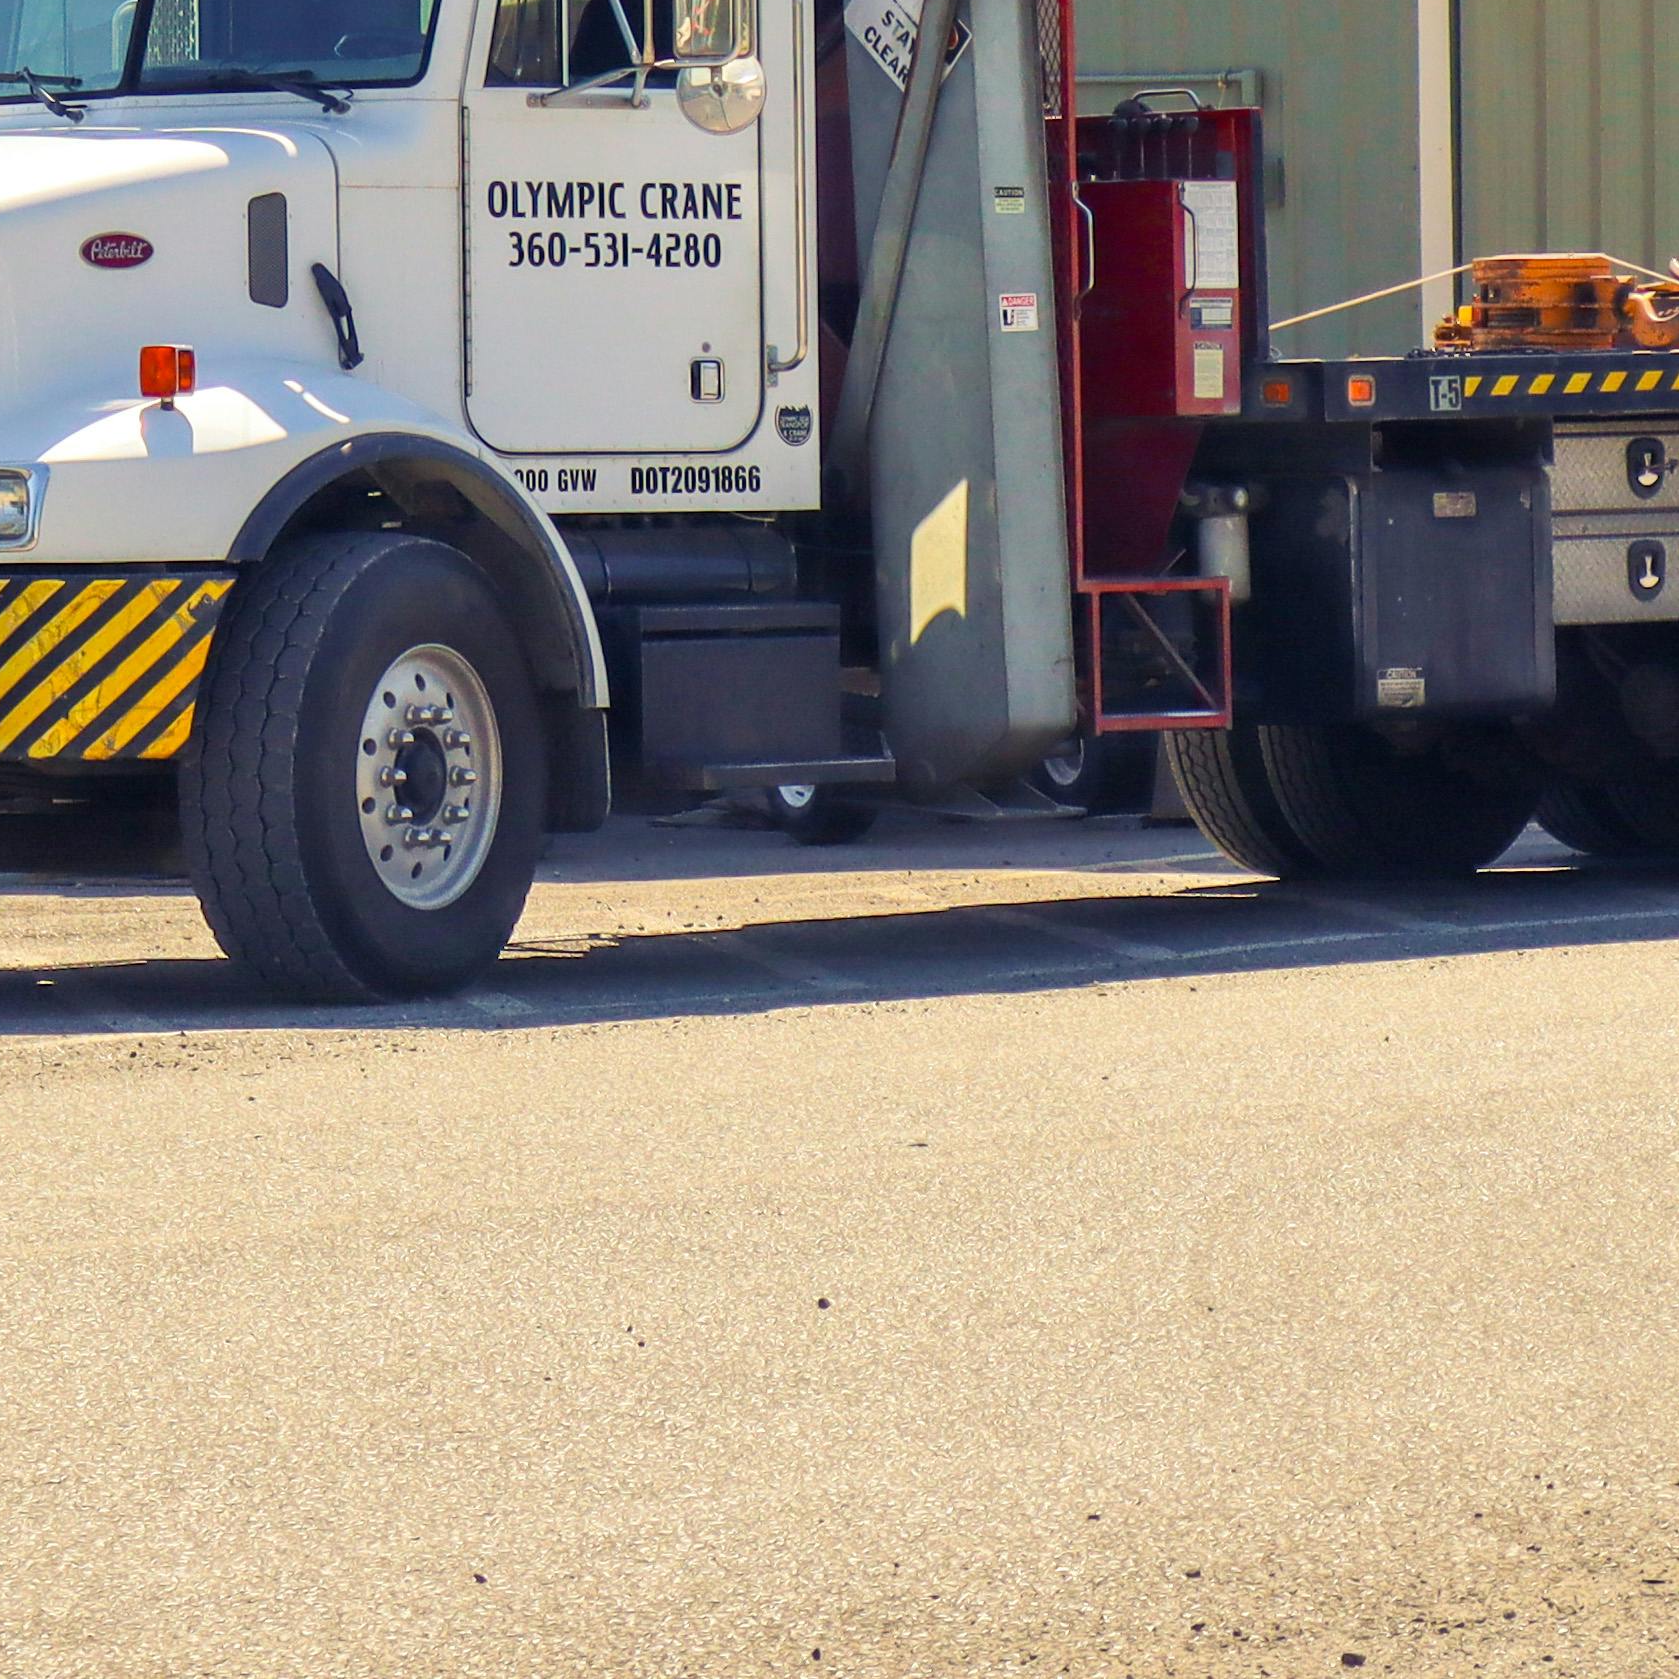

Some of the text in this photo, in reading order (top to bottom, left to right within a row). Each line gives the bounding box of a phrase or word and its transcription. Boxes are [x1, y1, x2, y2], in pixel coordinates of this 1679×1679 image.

[487, 181, 743, 220] OLYMPIC CRANE
[509, 232, 721, 268] 360-531-4280
[1431, 378, 1460, 409] T-5
[558, 468, 597, 492] GVW
[630, 466, 761, 494] DOT2091866
